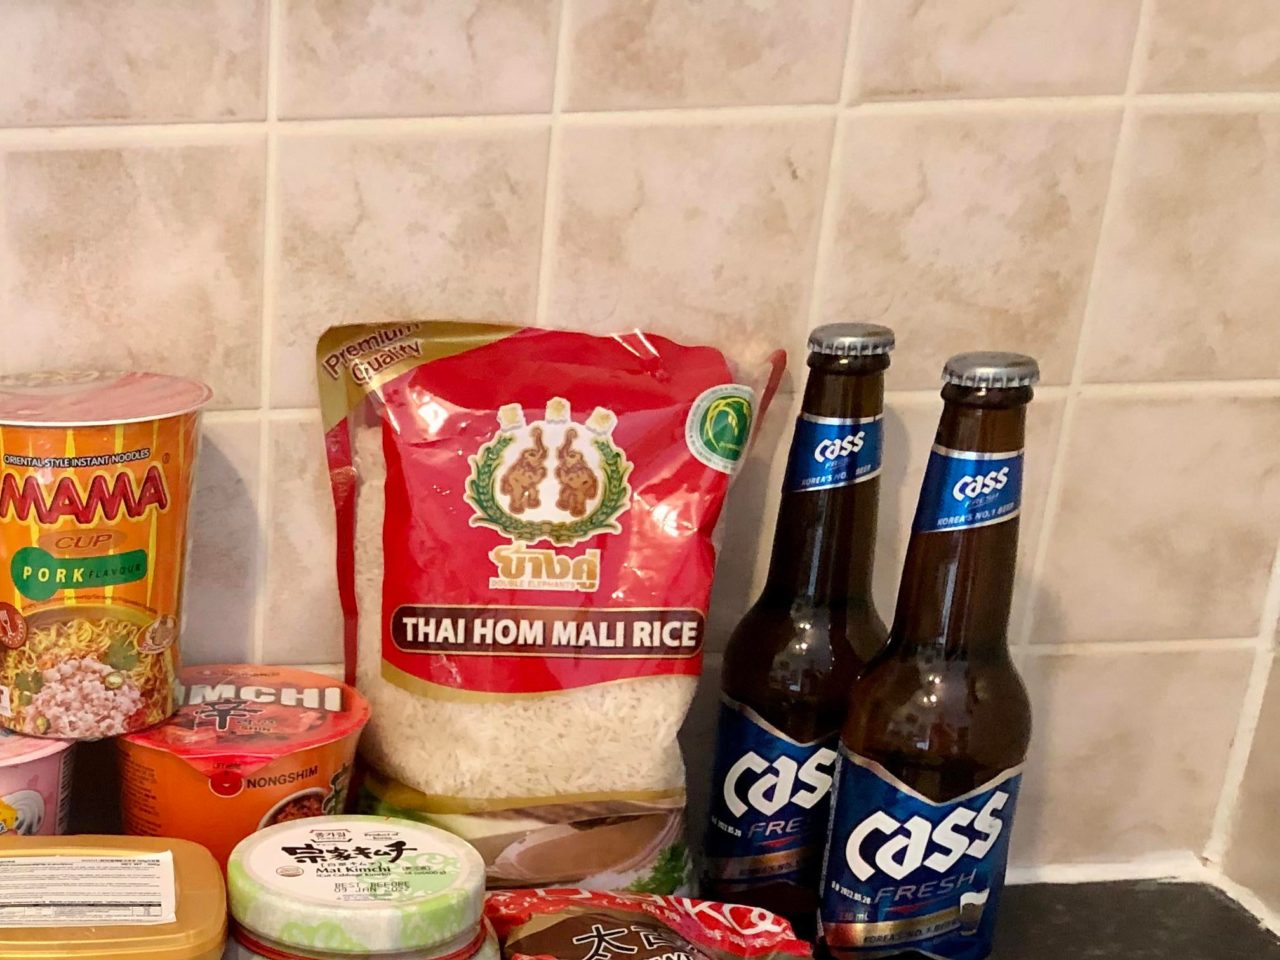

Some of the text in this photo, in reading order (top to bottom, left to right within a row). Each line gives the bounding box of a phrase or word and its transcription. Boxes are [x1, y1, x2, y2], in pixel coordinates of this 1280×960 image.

[352, 341, 422, 384] Quality
[71, 456, 110, 467] INSTANT
[111, 448, 151, 465] NOODLES
[55, 533, 113, 549] CUP
[23, 563, 142, 583] PORK FLAVOUR
[402, 616, 698, 648] THAI HOM MALI RICE
[179, 683, 342, 712] MCHI
[246, 765, 319, 789] NONGSHIM
[723, 747, 838, 818] Cas
[845, 790, 1010, 882] Cass
[873, 868, 977, 904] FRESH
